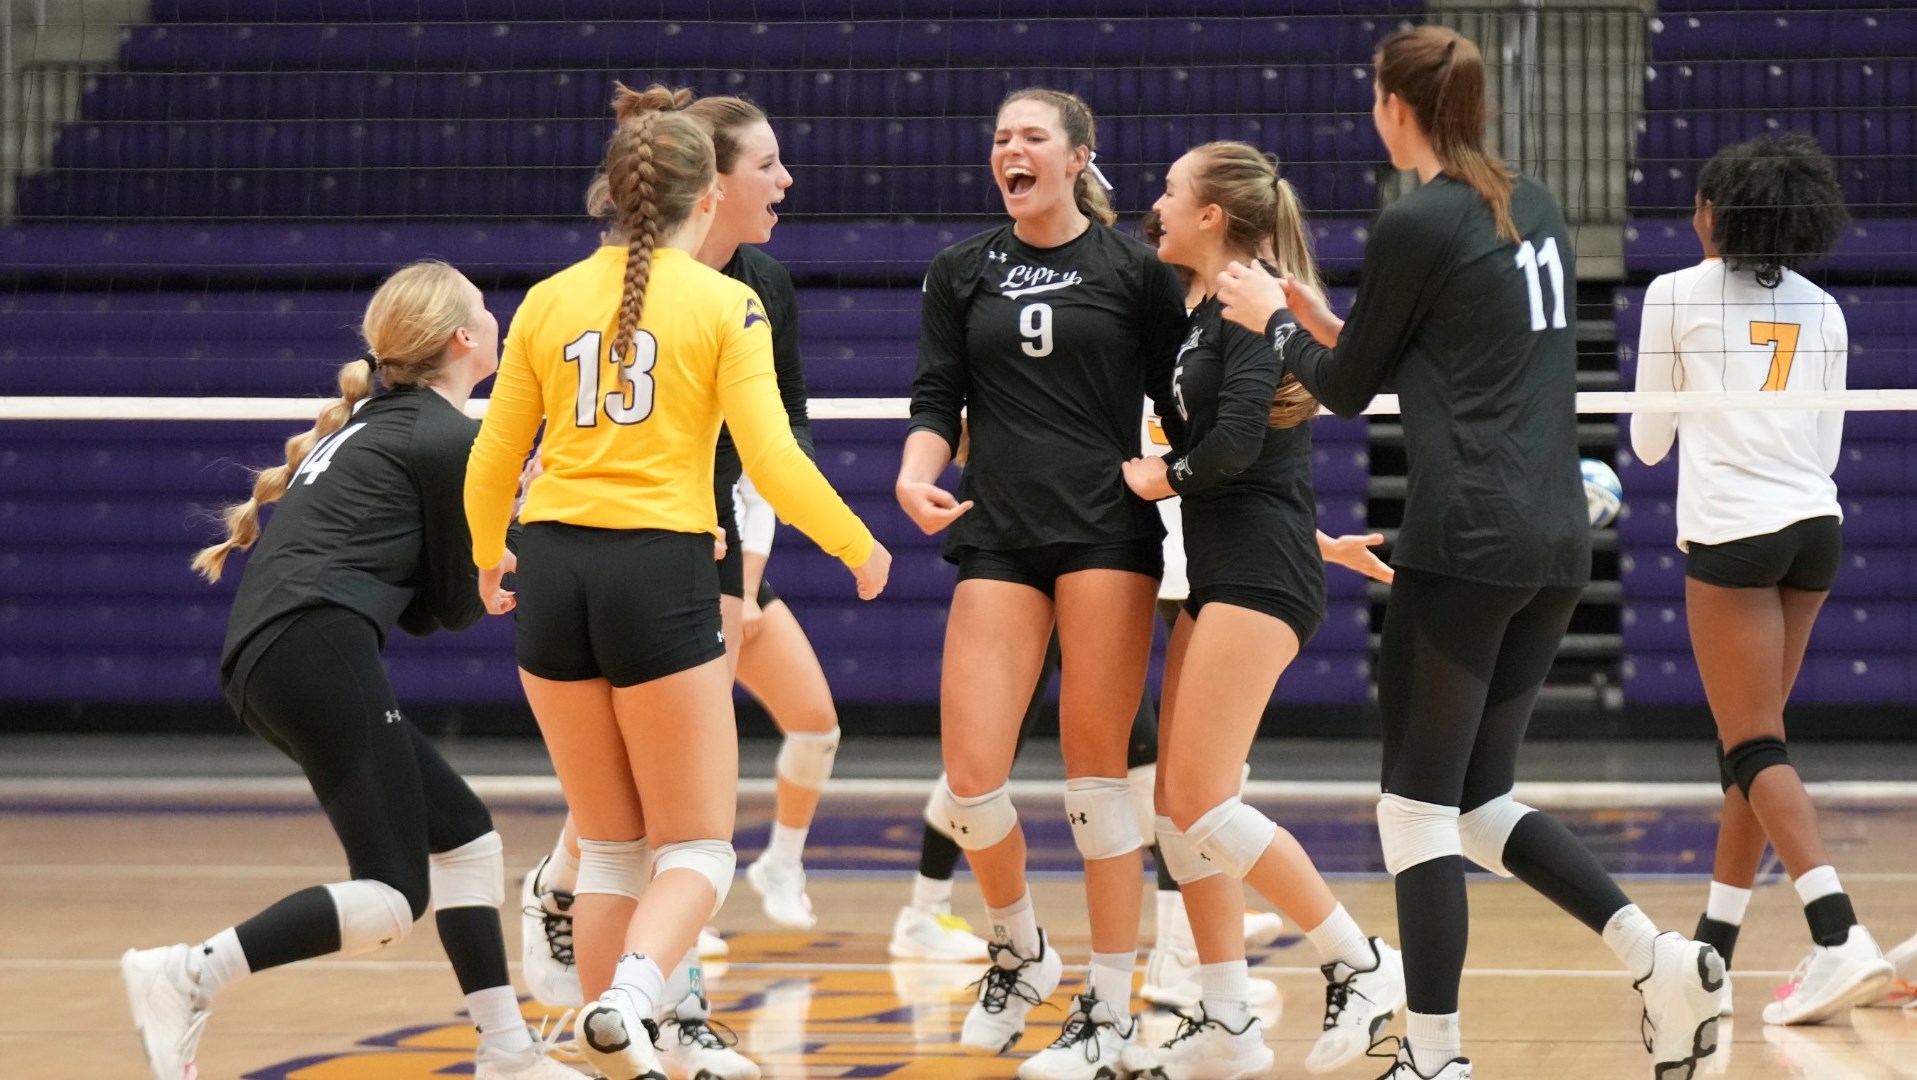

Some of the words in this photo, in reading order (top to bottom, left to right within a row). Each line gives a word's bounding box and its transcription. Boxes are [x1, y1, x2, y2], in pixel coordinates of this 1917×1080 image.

[1515, 236, 1567, 331] 11
[1020, 303, 1053, 357] 9
[1749, 320, 1801, 392] 7
[563, 328, 658, 428] 13
